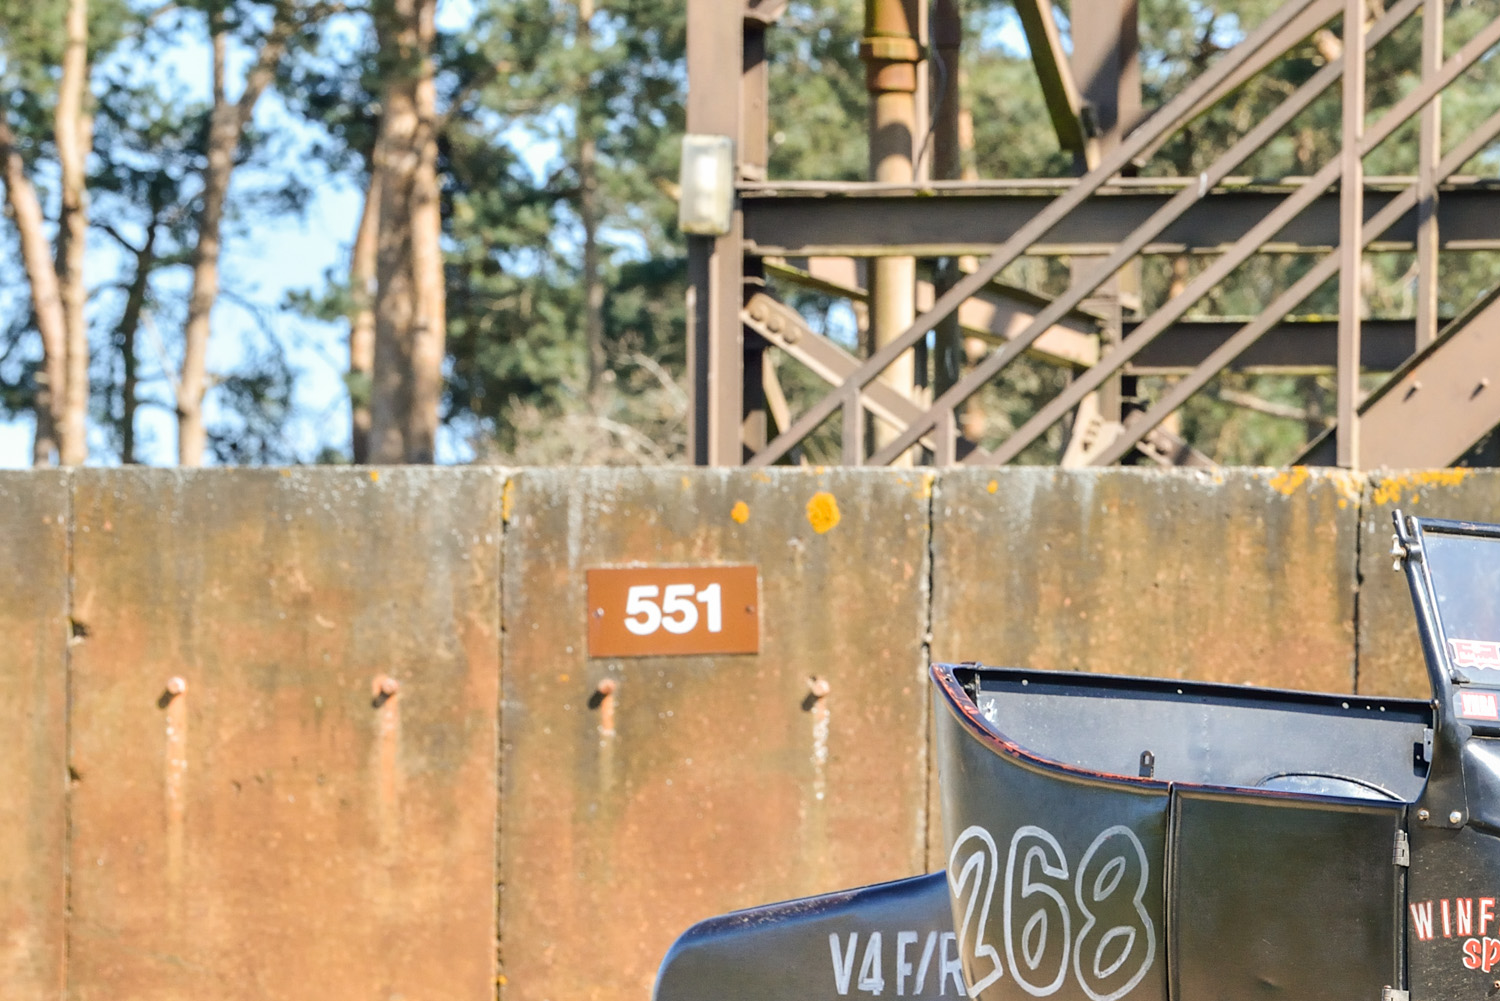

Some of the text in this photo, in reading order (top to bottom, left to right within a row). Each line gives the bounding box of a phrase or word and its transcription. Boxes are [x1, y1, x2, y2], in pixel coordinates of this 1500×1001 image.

[624, 583, 722, 635] 551
[829, 930, 967, 996] V4 F/R
